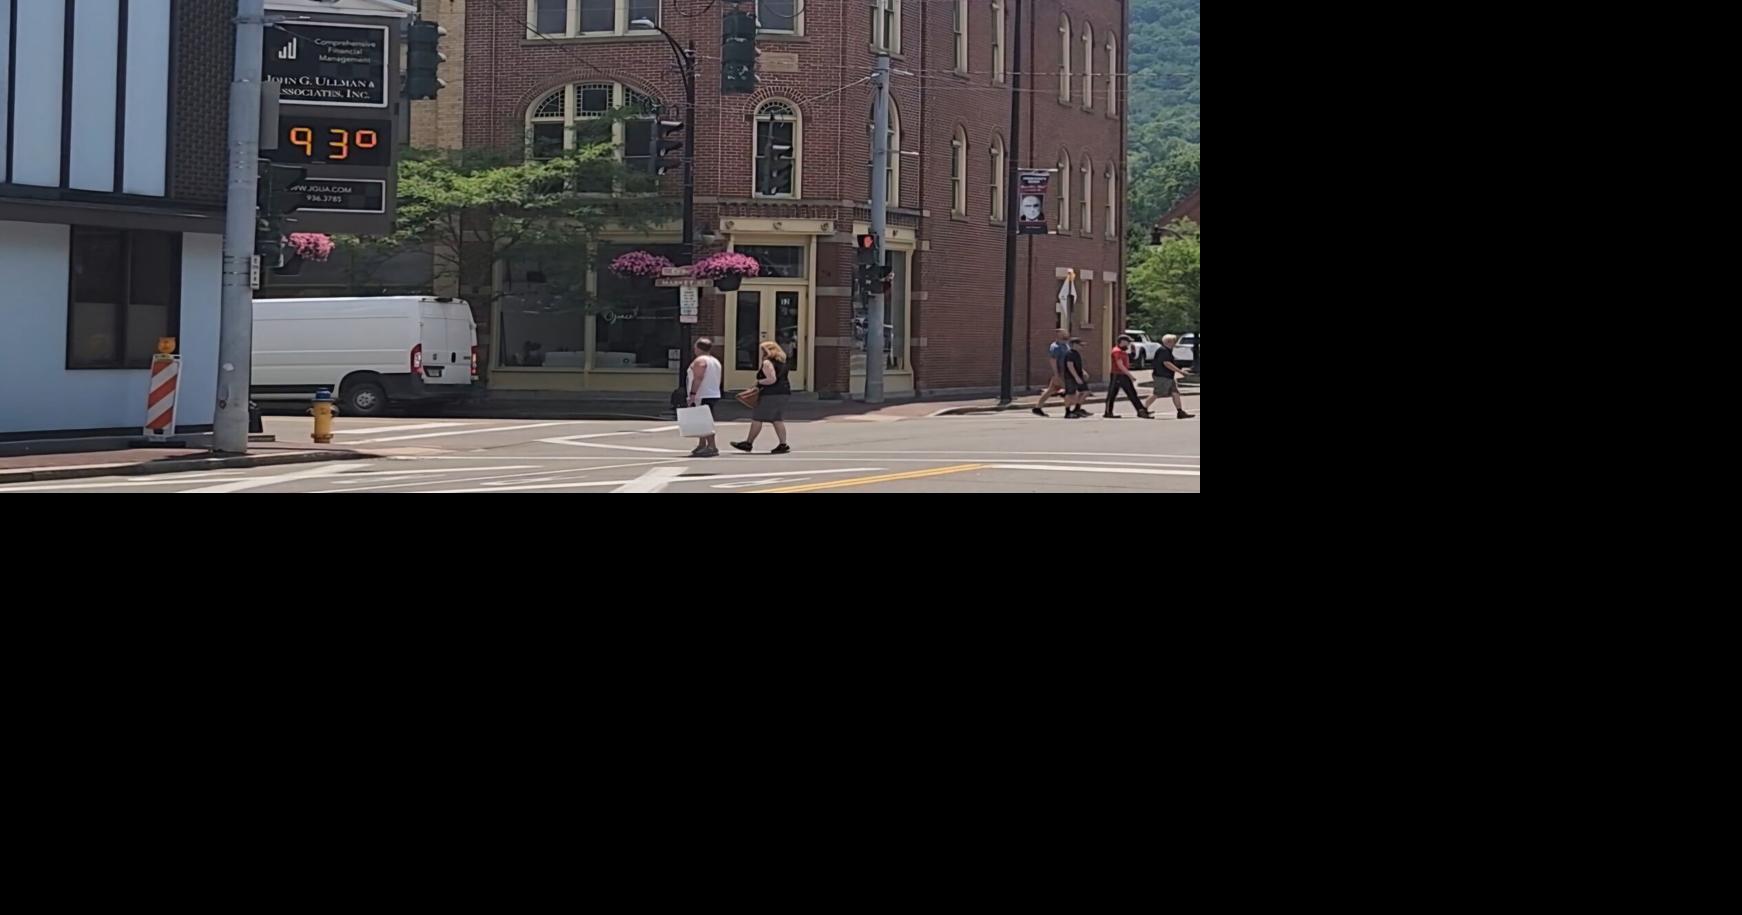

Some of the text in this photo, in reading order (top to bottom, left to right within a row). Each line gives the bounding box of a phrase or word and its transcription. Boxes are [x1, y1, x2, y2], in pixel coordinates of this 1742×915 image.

[314, 38, 376, 48] Comprehensive
[328, 46, 363, 55] Financial
[319, 54, 371, 64] Management
[299, 76, 312, 86] G.
[315, 77, 366, 88] ULLMAN
[280, 88, 370, 99] SSOCIATES, INC.
